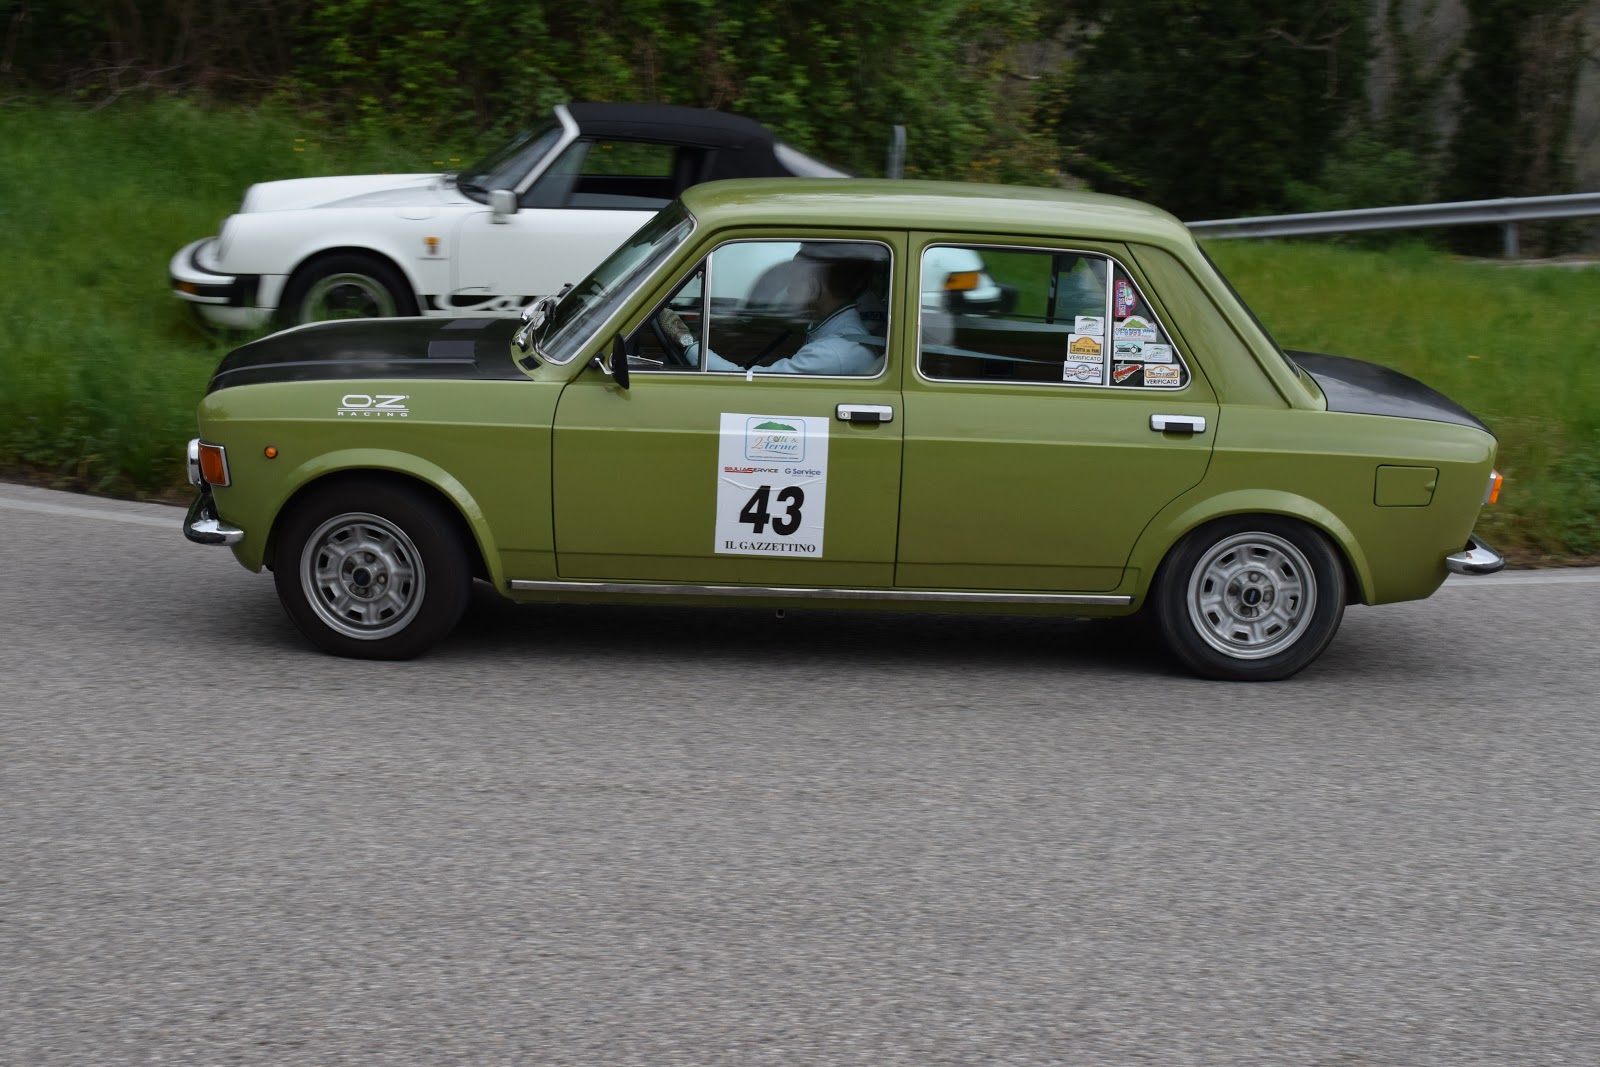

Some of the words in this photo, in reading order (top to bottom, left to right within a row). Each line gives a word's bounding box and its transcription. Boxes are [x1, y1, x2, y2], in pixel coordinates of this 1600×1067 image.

[751, 436, 763, 450] 2
[766, 434, 789, 443] Colli
[763, 441, 799, 451] Terme
[792, 467, 821, 476] Service
[739, 485, 805, 536] 43
[725, 540, 737, 550] IL
[739, 541, 816, 553] GAZZETTINO
